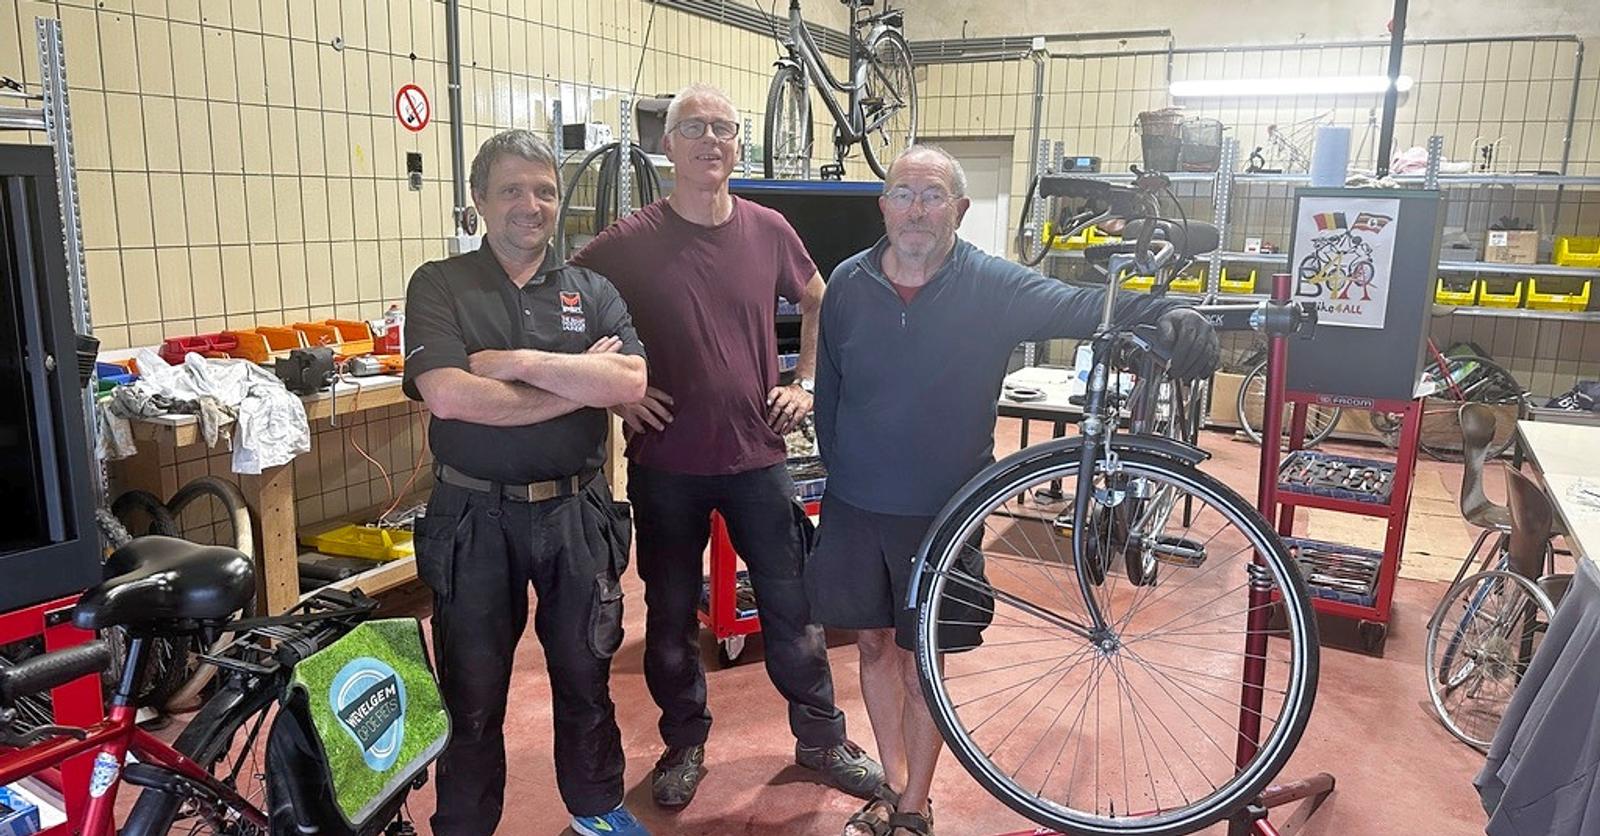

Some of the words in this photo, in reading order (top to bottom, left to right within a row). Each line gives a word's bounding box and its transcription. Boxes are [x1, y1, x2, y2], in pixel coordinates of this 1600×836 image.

[345, 684, 396, 727] WEVELGEM
[357, 724, 369, 740] OP
[366, 715, 381, 732] DE
